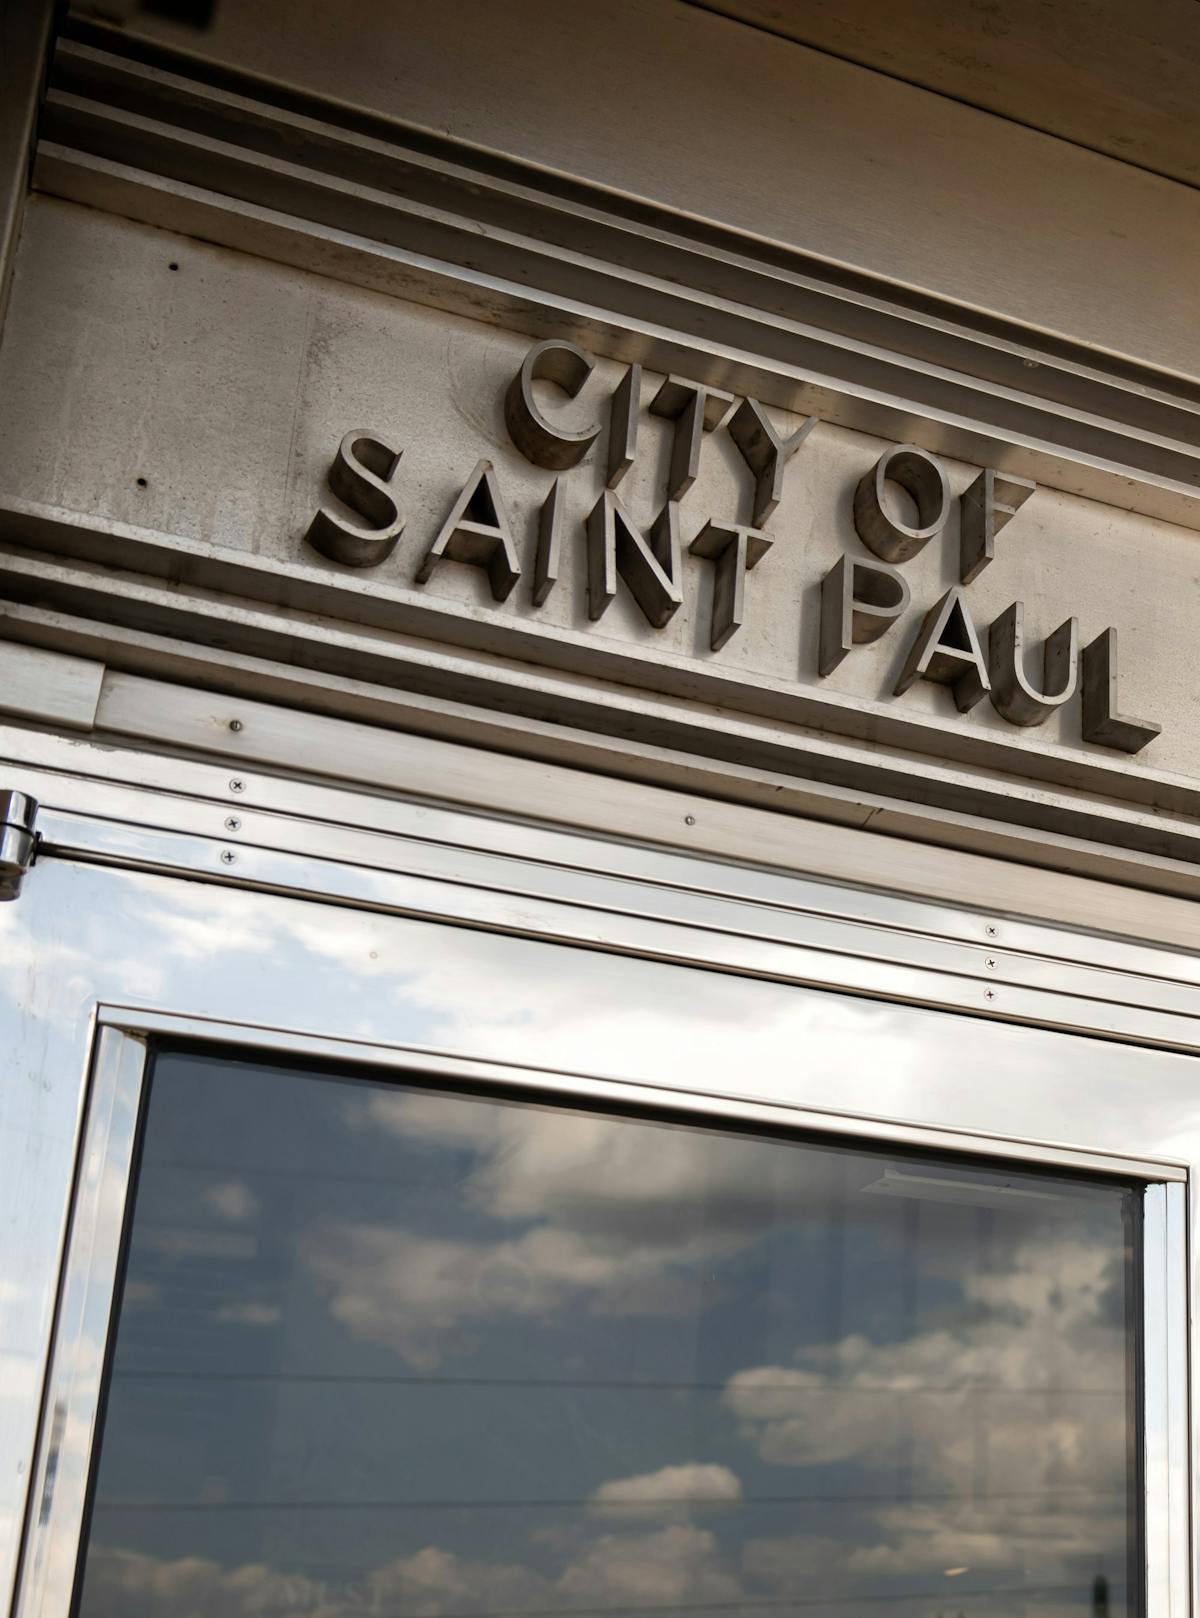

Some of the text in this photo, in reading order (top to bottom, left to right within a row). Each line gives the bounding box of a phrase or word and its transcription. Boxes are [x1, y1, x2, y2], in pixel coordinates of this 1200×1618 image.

[304, 428, 1162, 755] SAINT PAUL
[505, 339, 1037, 585] CITY OF
